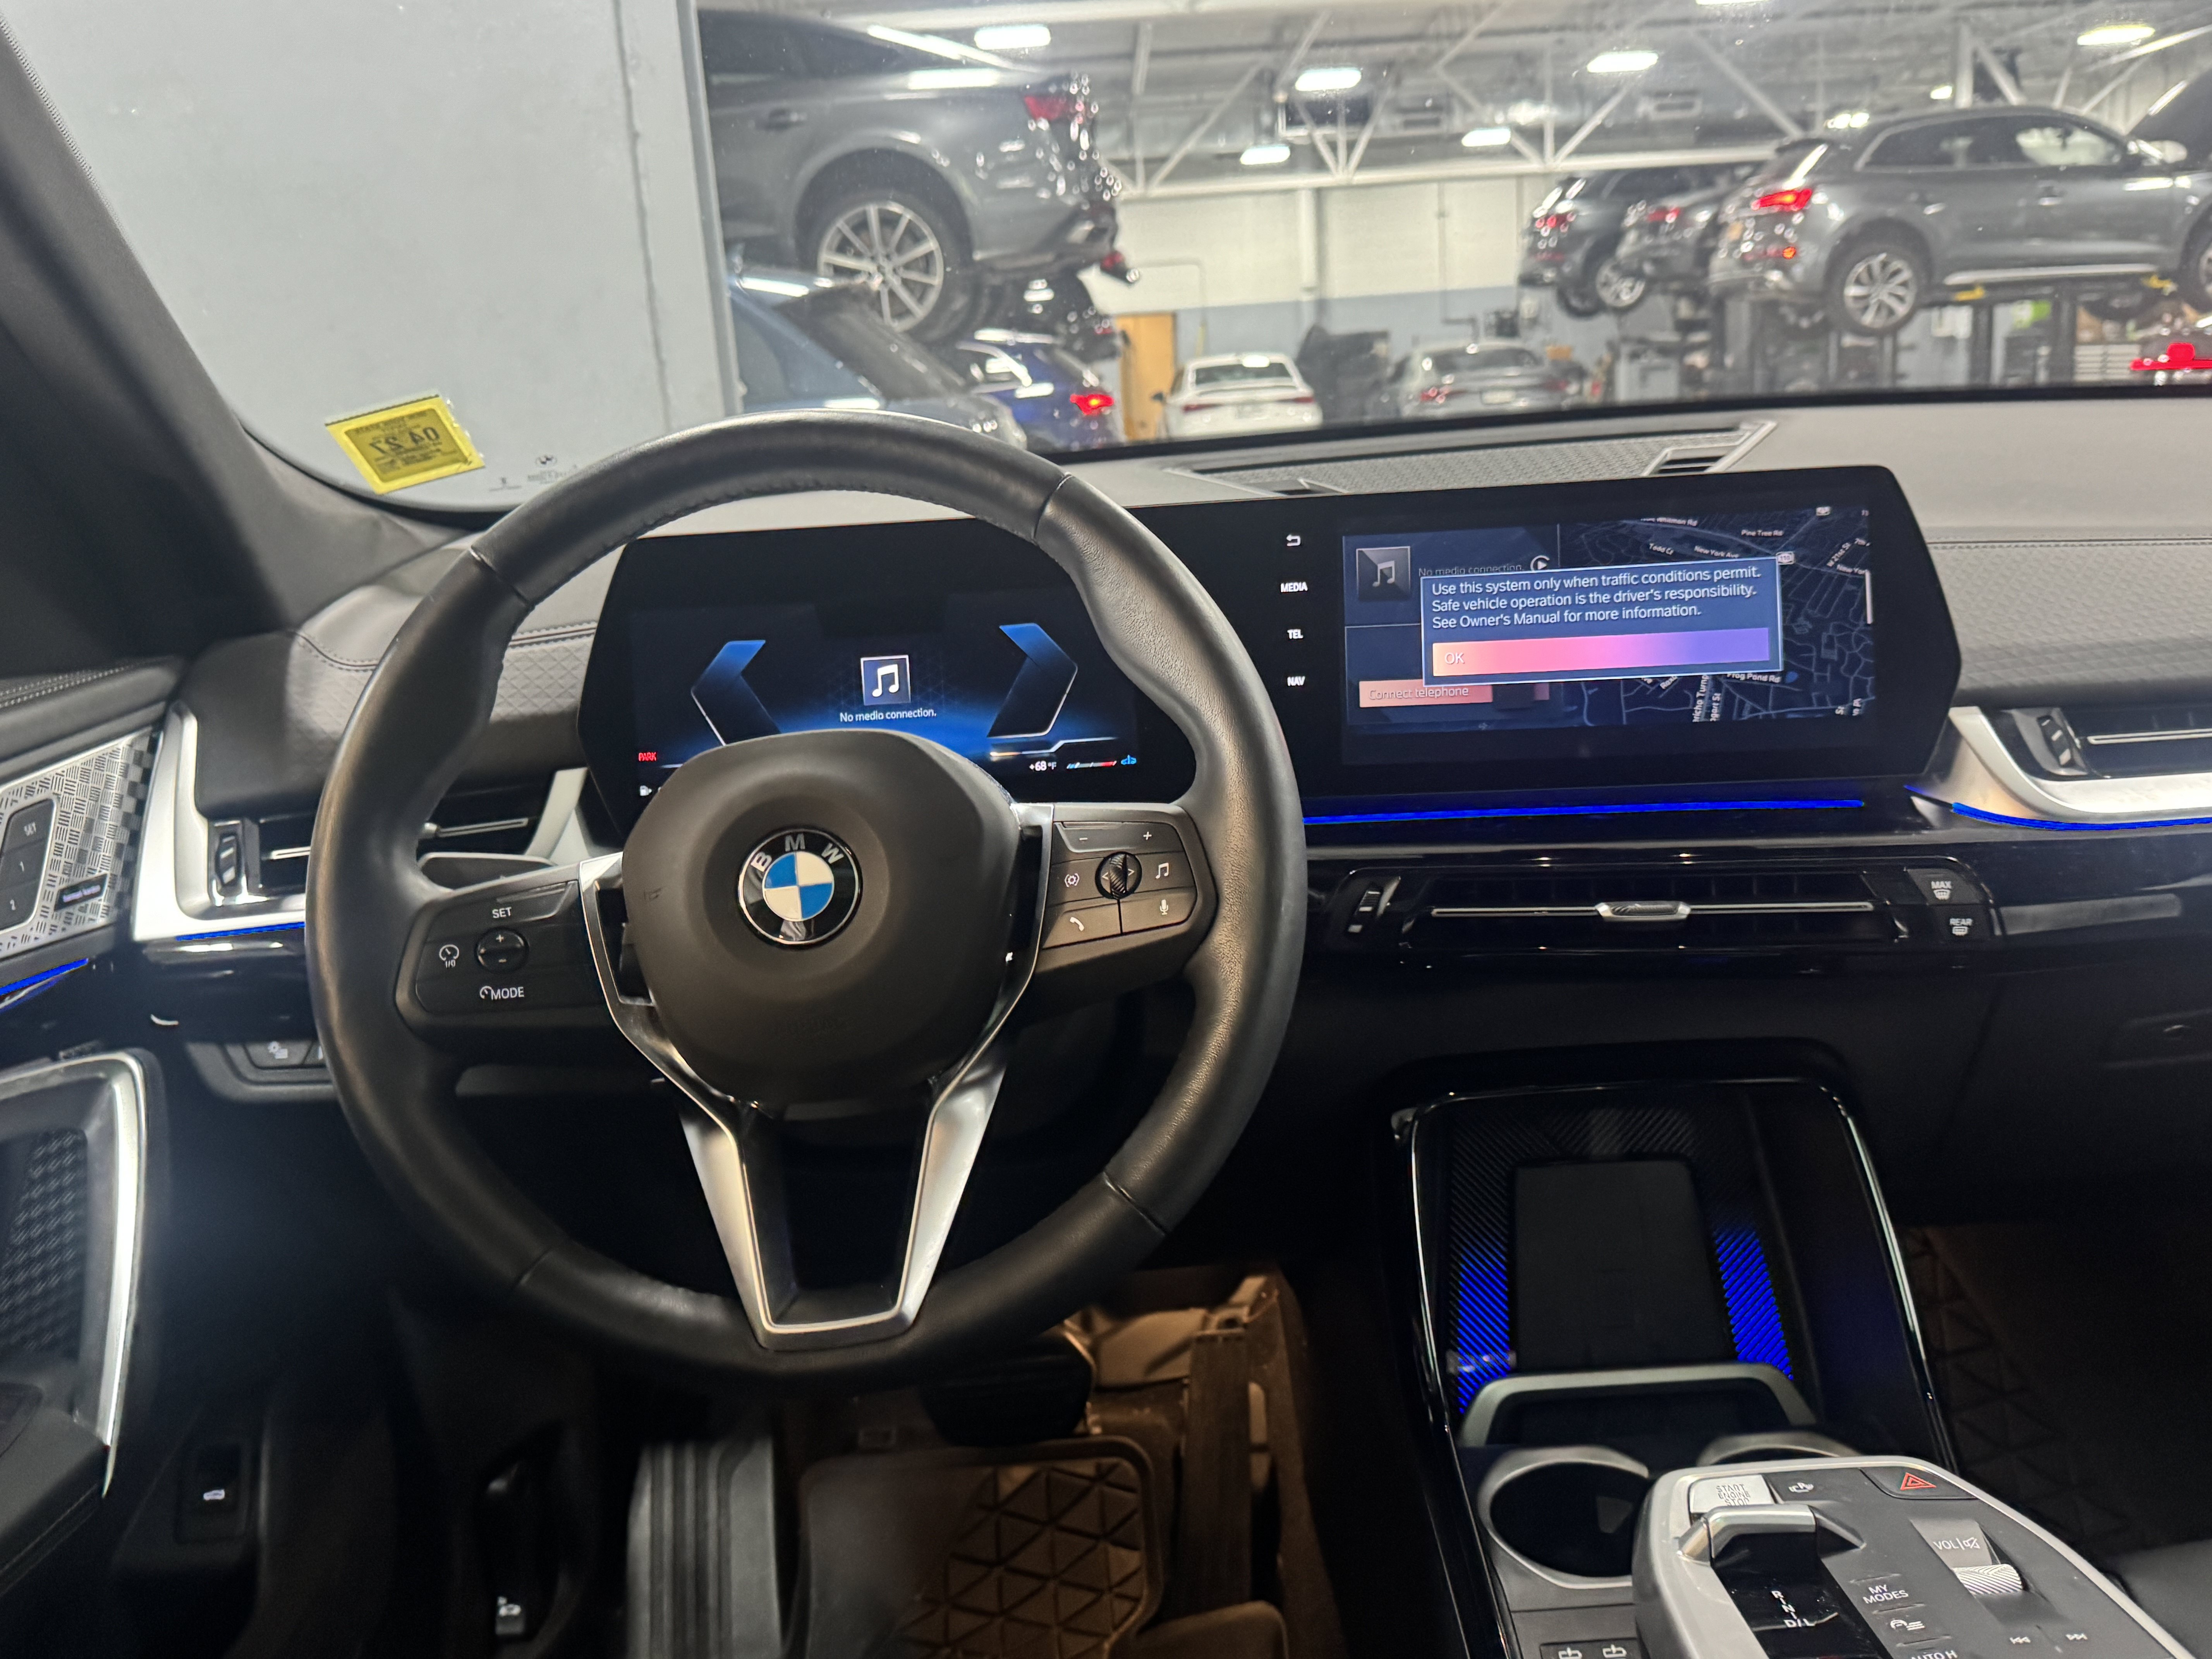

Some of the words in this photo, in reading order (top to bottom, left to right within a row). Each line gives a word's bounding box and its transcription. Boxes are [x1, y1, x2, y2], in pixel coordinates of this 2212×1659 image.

[1694, 545, 1710, 554] New
[1710, 549, 1725, 557] York
[1419, 568, 1432, 577] No
[1435, 566, 1466, 575] media
[1432, 583, 1456, 595] Use
[1460, 581, 1483, 594] this
[1486, 580, 1531, 595] system
[1534, 578, 1561, 591] only
[1563, 576, 1598, 588] when
[1601, 573, 1639, 586] traffic
[1641, 570, 1711, 584] conditions
[1714, 565, 1761, 583] permit.
[1281, 582, 1308, 592] MEDIA
[1432, 599, 1460, 612] Safe
[1463, 597, 1507, 611] vehicle
[1510, 594, 1572, 610] operation
[1575, 592, 1587, 605] is
[1589, 591, 1611, 604] the
[1613, 589, 1662, 603] driver's
[1665, 584, 1757, 601] responsibility.
[1432, 616, 1457, 629] See
[1460, 613, 1511, 627] Owner's
[1514, 611, 1560, 625] Manual
[1564, 609, 1583, 622] for
[1585, 610, 1619, 621] more
[1622, 604, 1702, 619] information.
[1287, 629, 1304, 639] TEL
[1444, 653, 1465, 665] OK
[1287, 676, 1306, 687] NAV
[1369, 689, 1413, 700] Connect
[1415, 686, 1469, 699] telephone
[840, 712, 854, 722] No
[855, 710, 884, 721] media
[885, 707, 937, 720] connection.
[639, 752, 657, 761] PARK
[750, 833, 844, 872] BMW
[1931, 881, 1952, 889] MAX
[492, 907, 512, 919] SET
[1949, 918, 1973, 926] REAR
[491, 986, 525, 1000] MODE
[1716, 1484, 1745, 1493] START
[1868, 1584, 1888, 1594] MY
[1863, 1590, 1909, 1604] MODES
[1945, 1650, 1958, 1659] H
